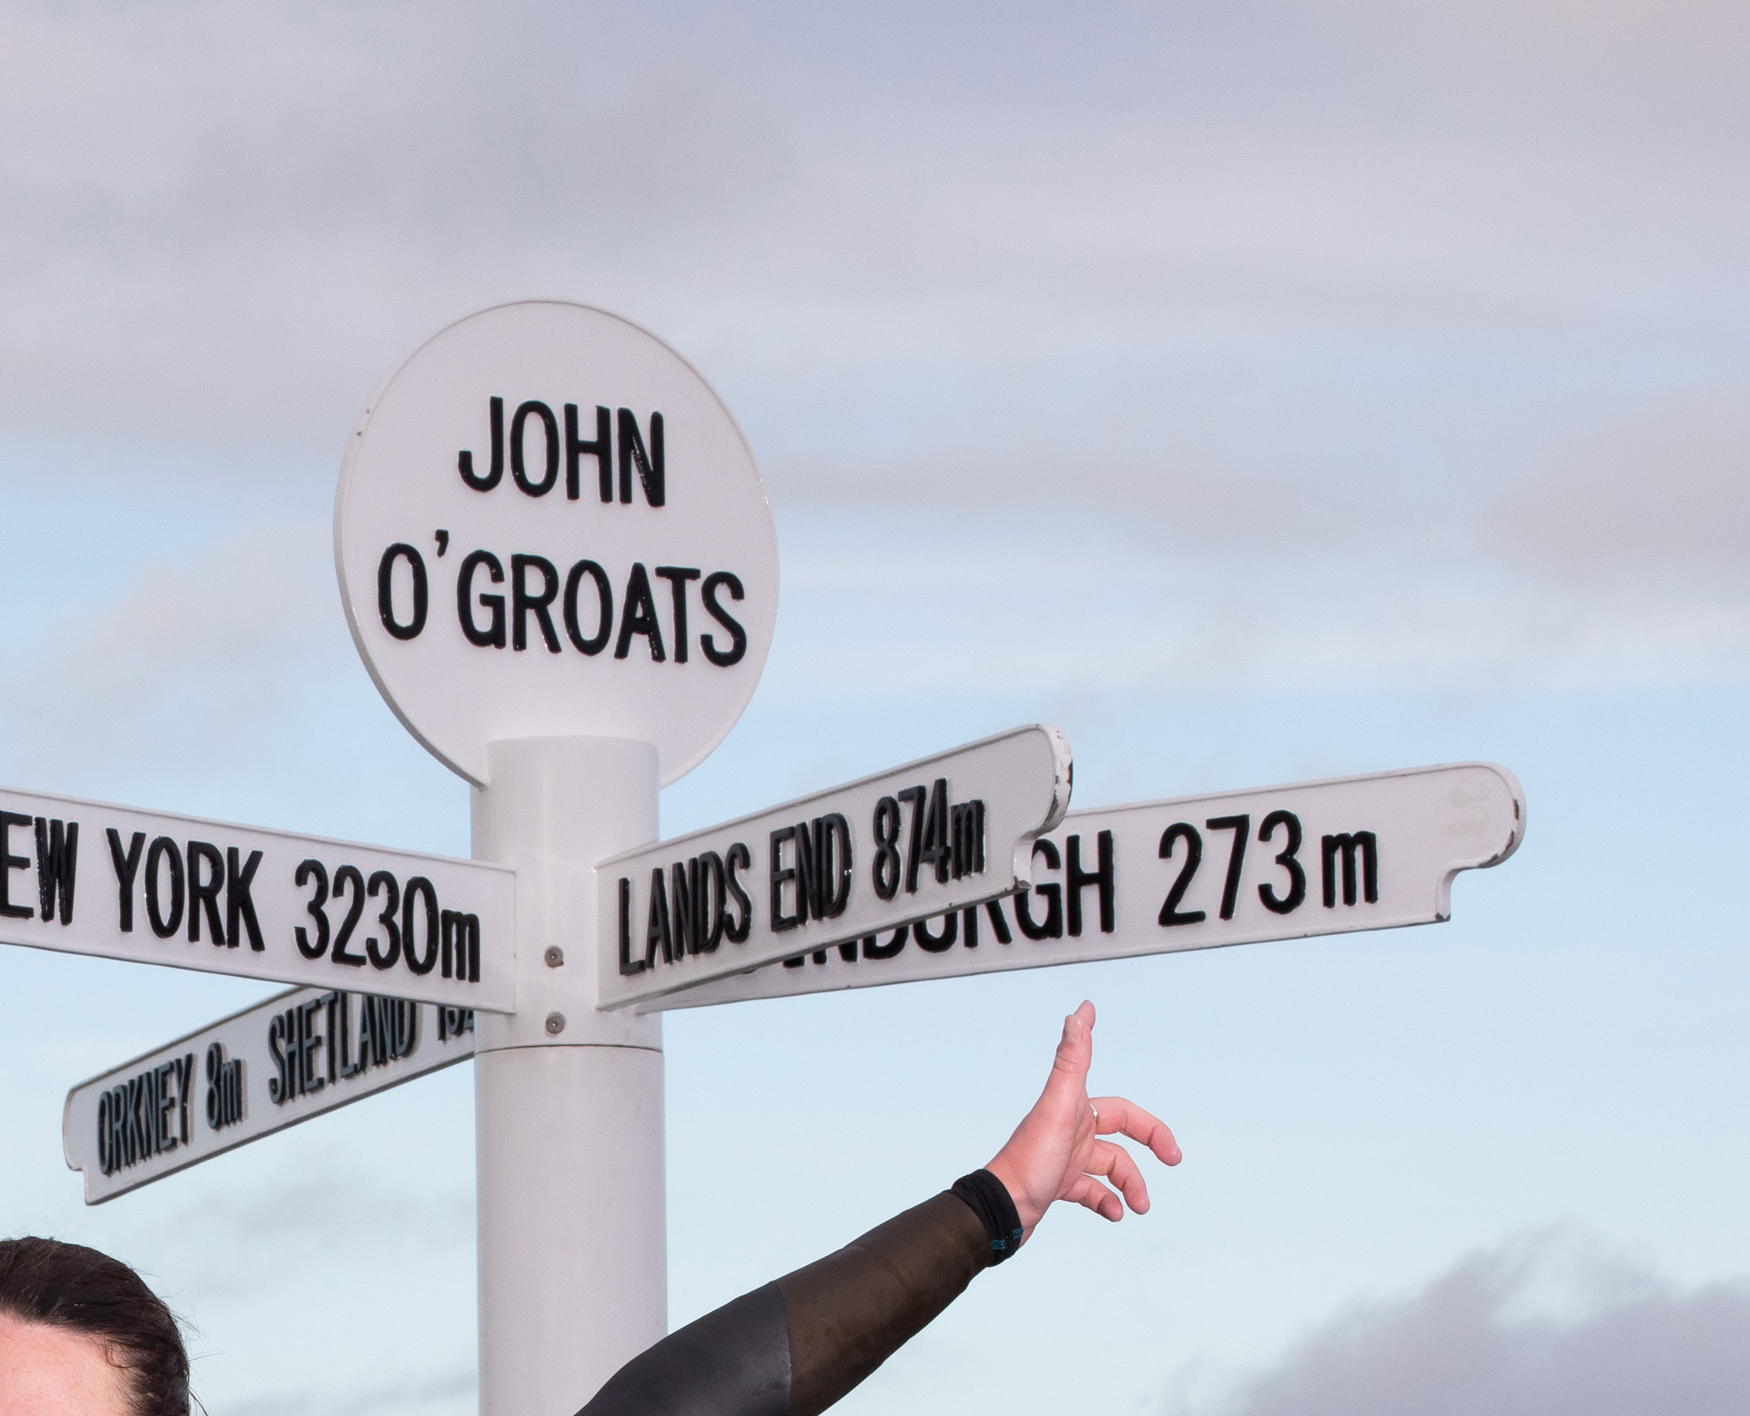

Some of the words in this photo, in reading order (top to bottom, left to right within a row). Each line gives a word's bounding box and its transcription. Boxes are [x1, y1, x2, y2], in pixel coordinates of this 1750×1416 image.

[458, 396, 665, 508] JOHN
[377, 529, 747, 667] O'GROATS
[106, 826, 266, 951] YORK
[294, 859, 481, 982] 3230m
[618, 843, 752, 976] LANDS
[770, 813, 853, 932] END
[872, 778, 985, 901] 874m
[97, 1053, 194, 1176] ORKNEY
[206, 1042, 243, 1131] 8m
[268, 991, 417, 1104] SHETLAND
